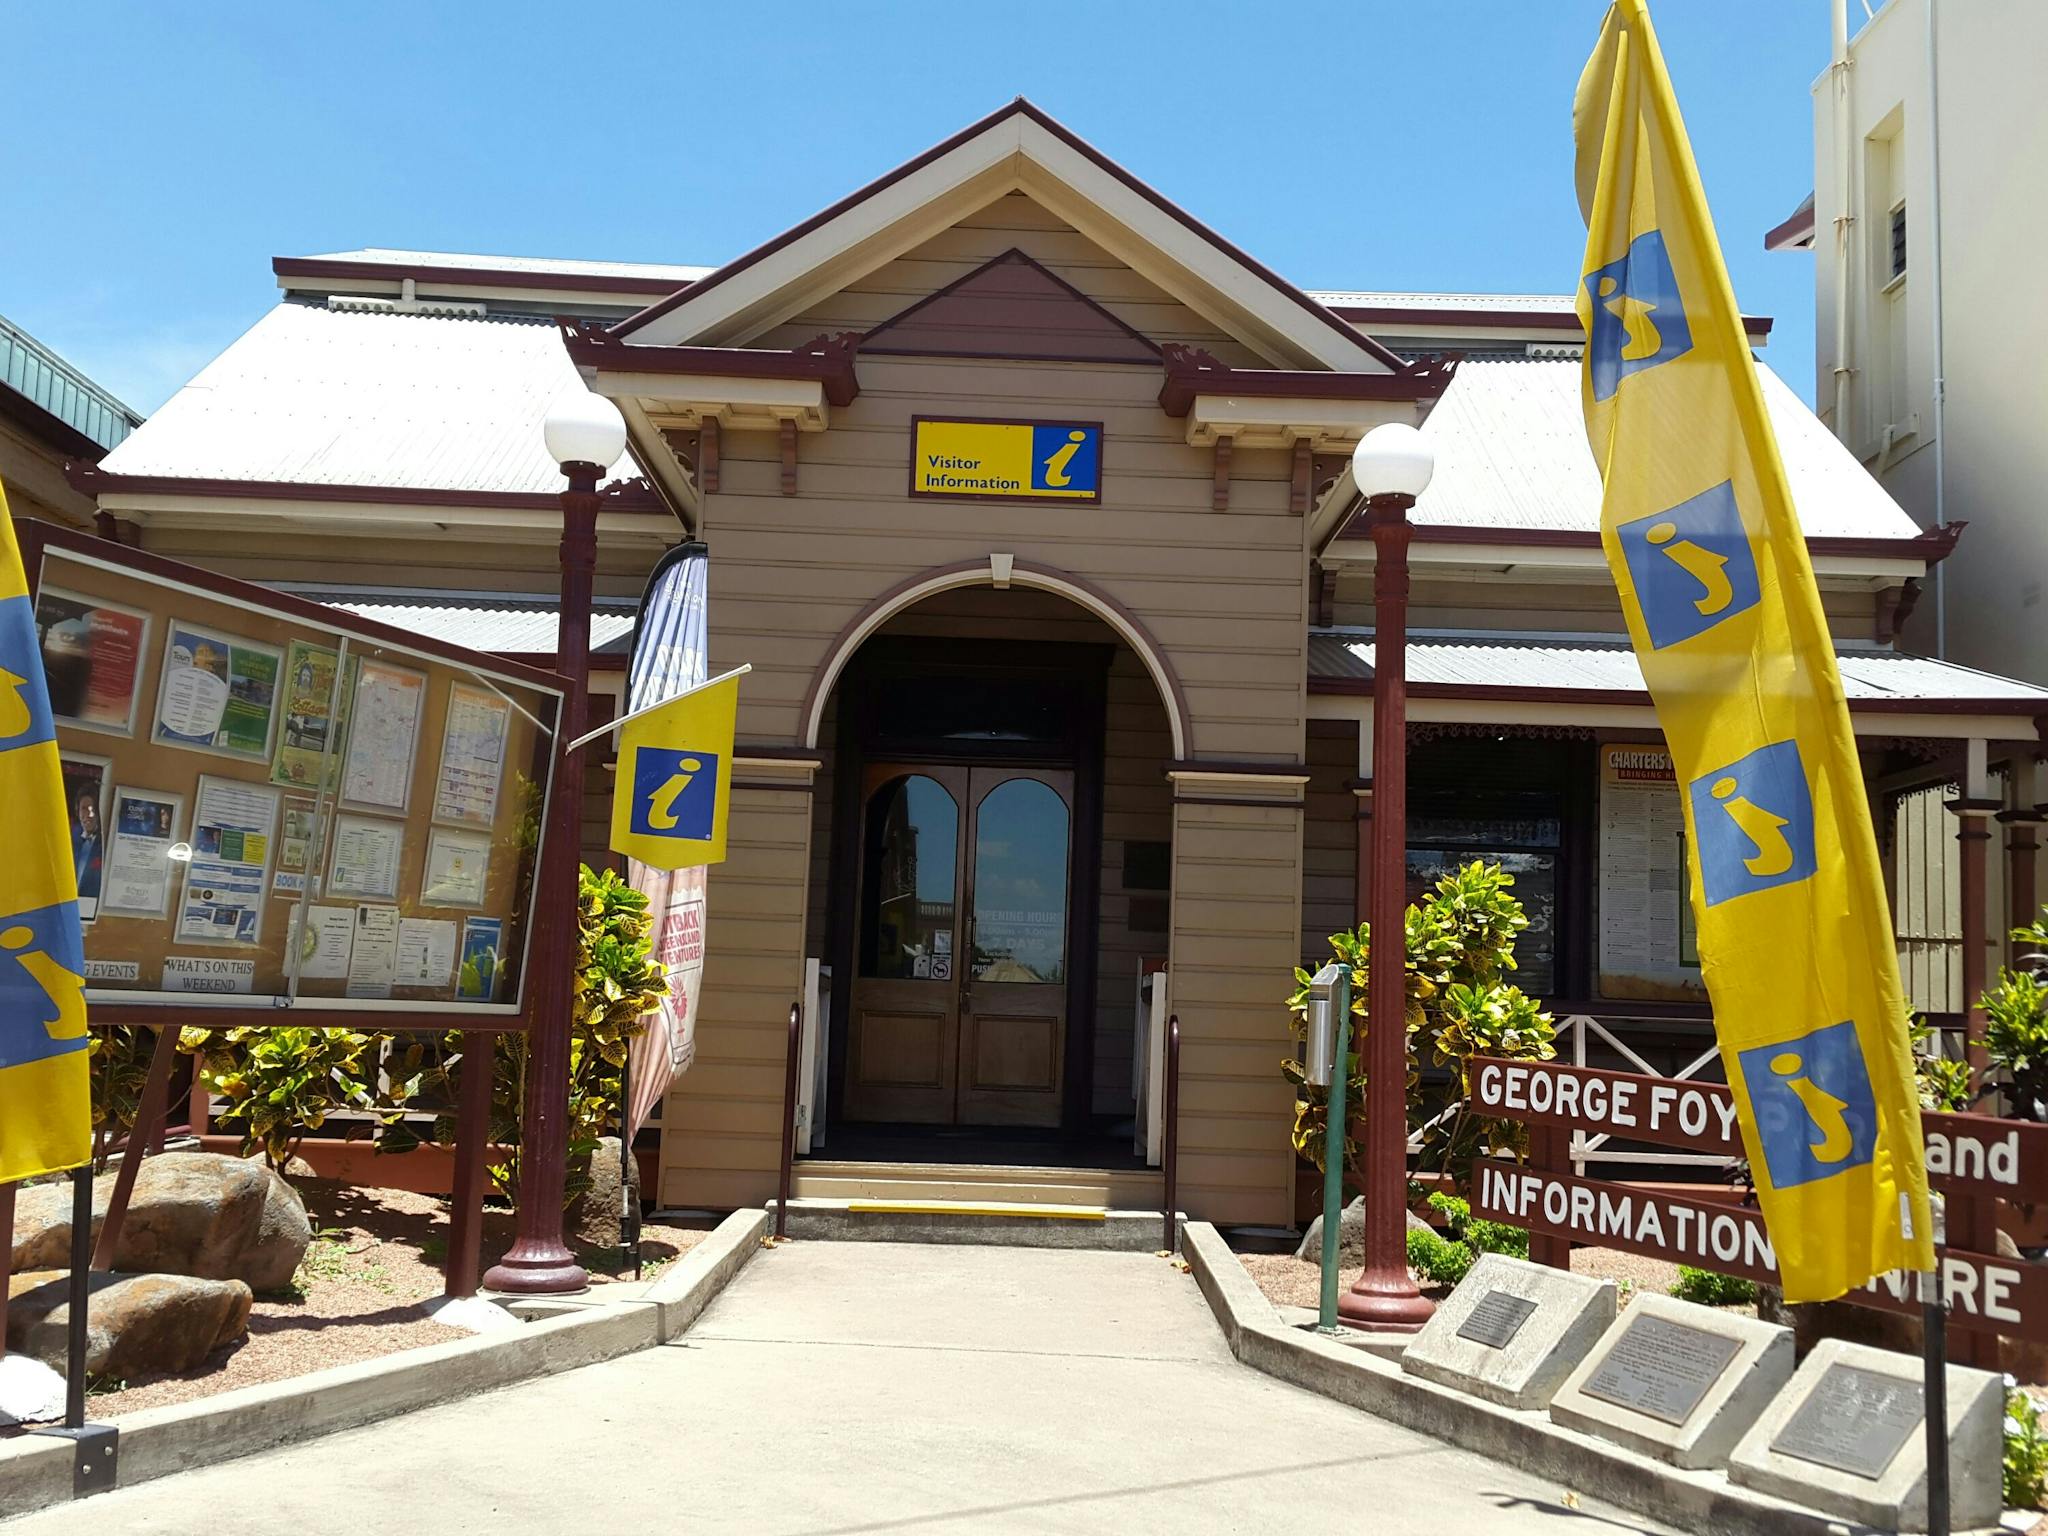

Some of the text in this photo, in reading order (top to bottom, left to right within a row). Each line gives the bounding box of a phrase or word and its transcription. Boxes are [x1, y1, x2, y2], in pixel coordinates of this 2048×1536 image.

[928, 455, 981, 470] Visitor
[926, 473, 1020, 490] Information
[1608, 751, 1666, 770] CHARTERS
[93, 964, 136, 978] EVENTS
[167, 959, 253, 975] WHAT'S ON THIS
[182, 977, 236, 991] WEEKEND
[1480, 1064, 1637, 1127] GEORGE
[1924, 1130, 2019, 1185] and
[1480, 1167, 1778, 1271] INFORMATION
